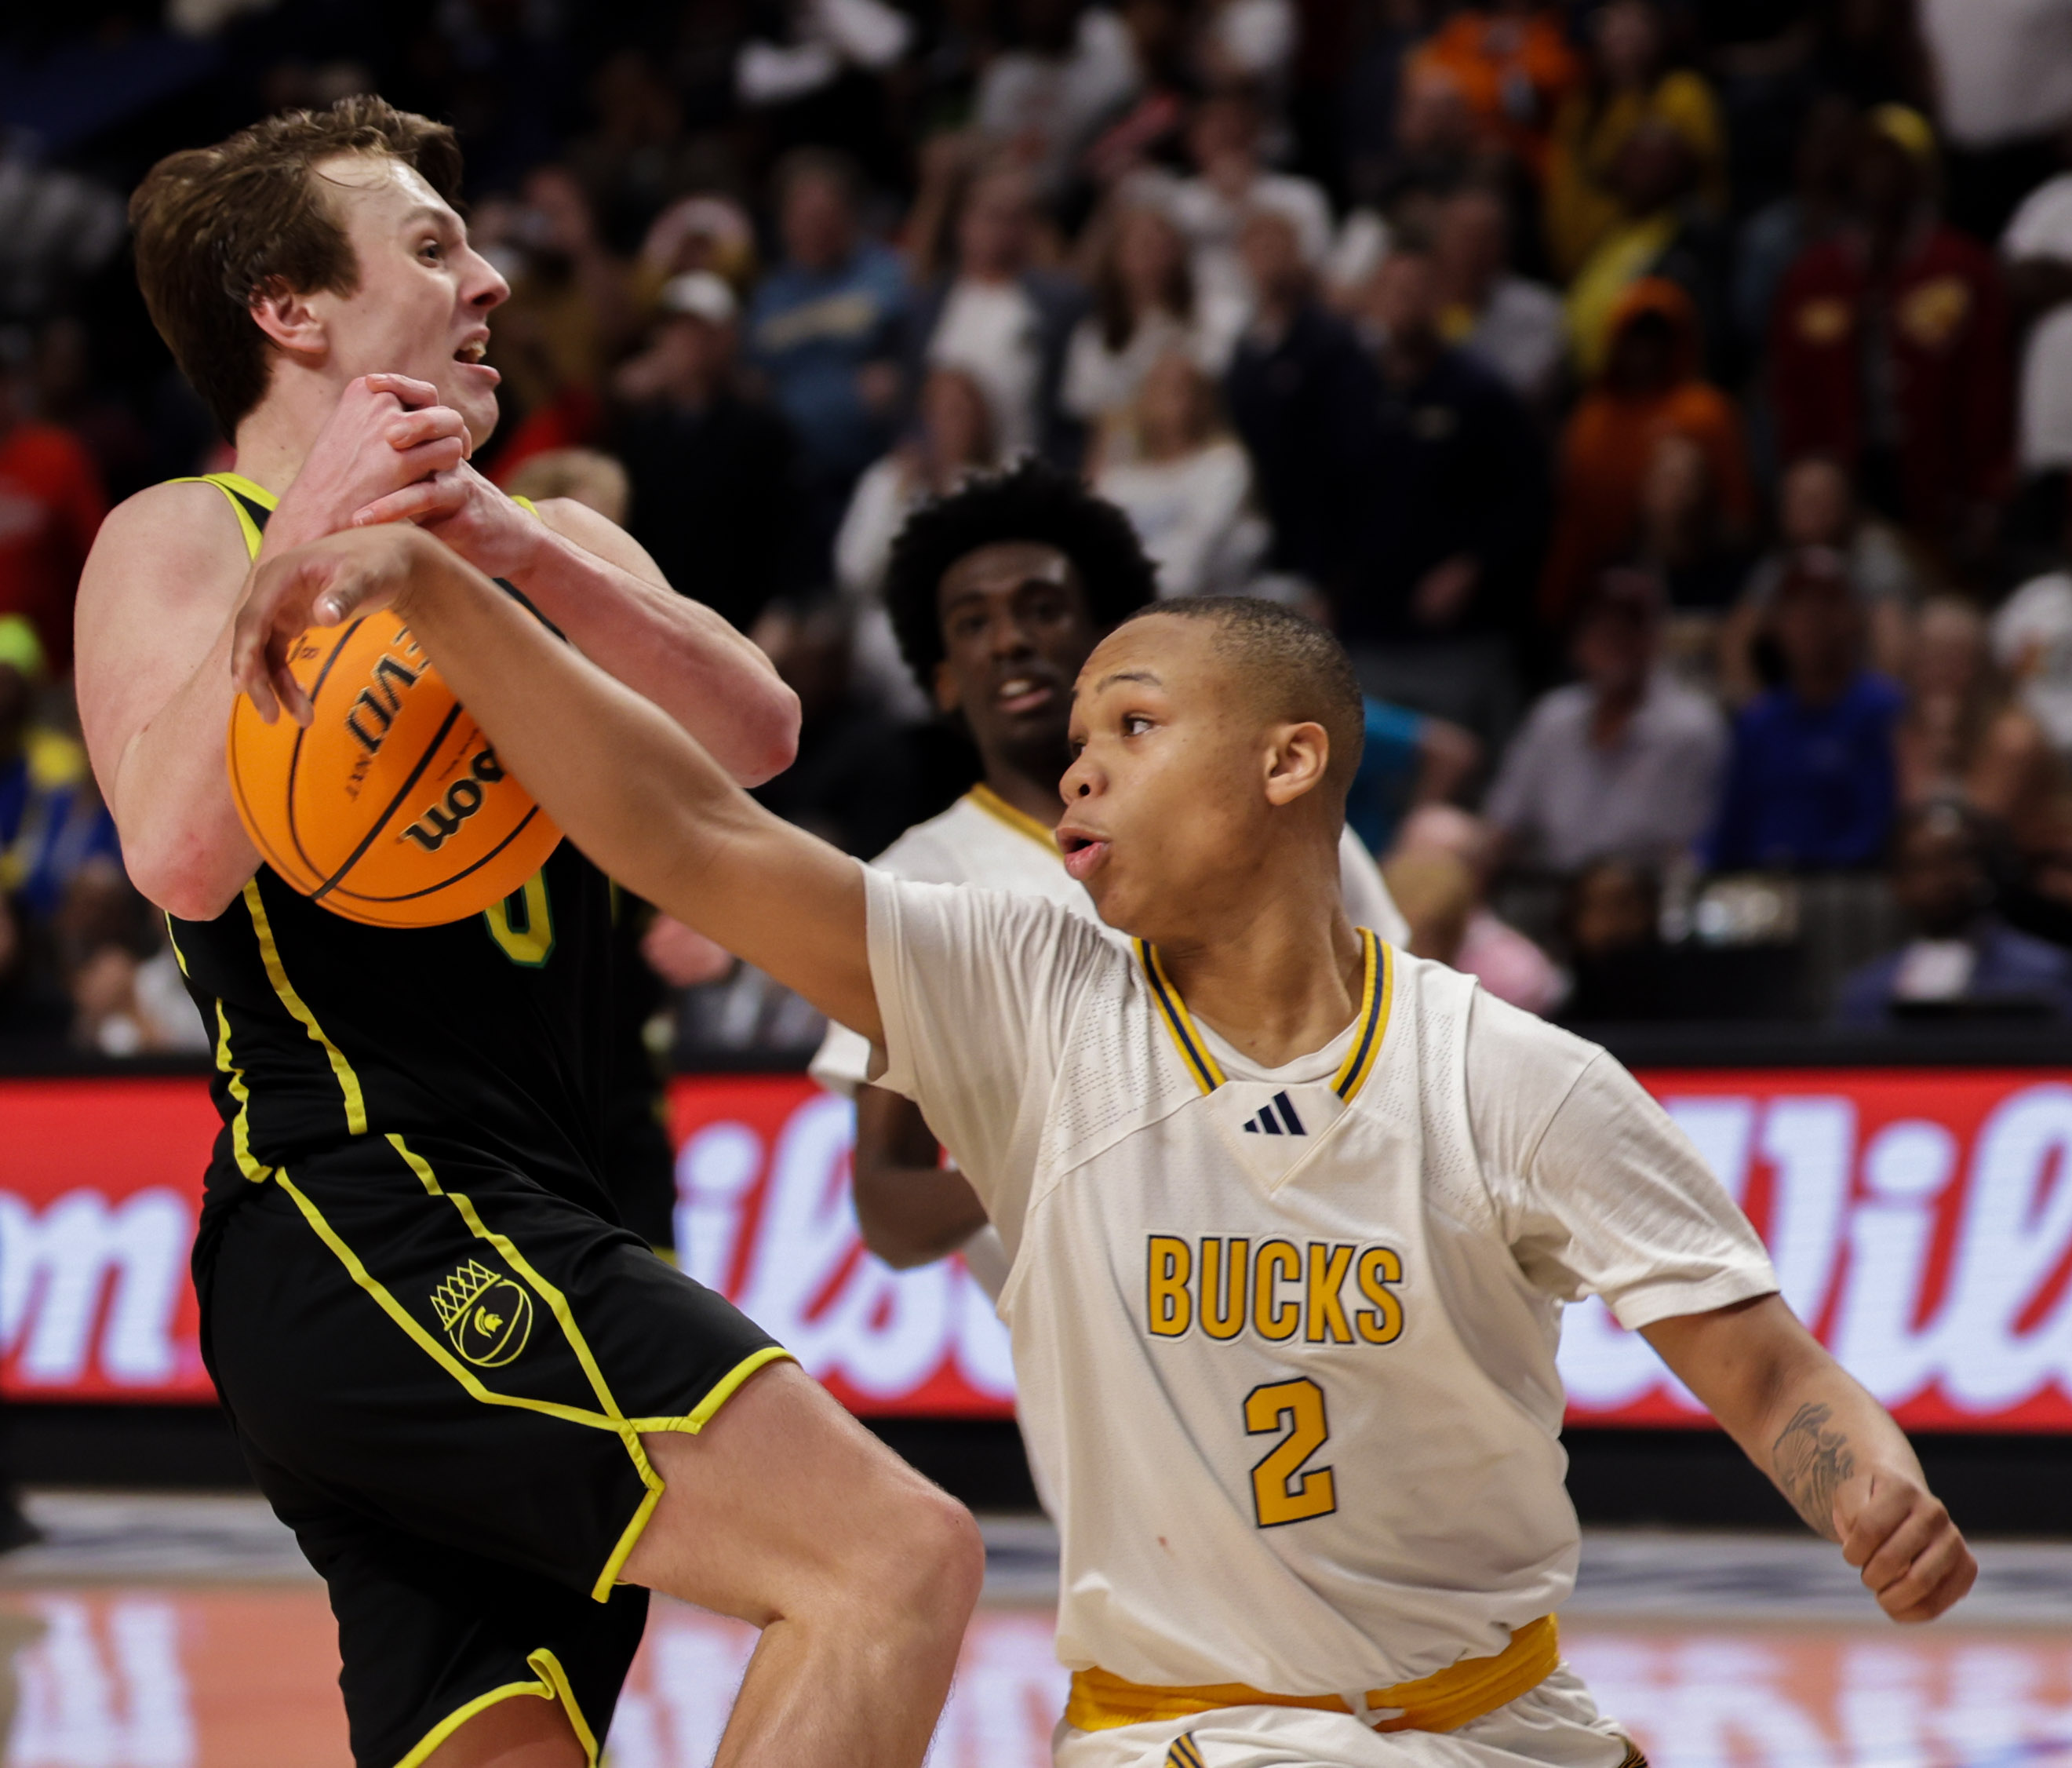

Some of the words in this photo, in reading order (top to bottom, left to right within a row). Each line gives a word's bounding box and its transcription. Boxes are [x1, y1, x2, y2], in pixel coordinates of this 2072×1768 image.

[399, 745, 505, 853] son
[1147, 1234, 1404, 1345] BUCKS
[1243, 1376, 1337, 1529] 2
